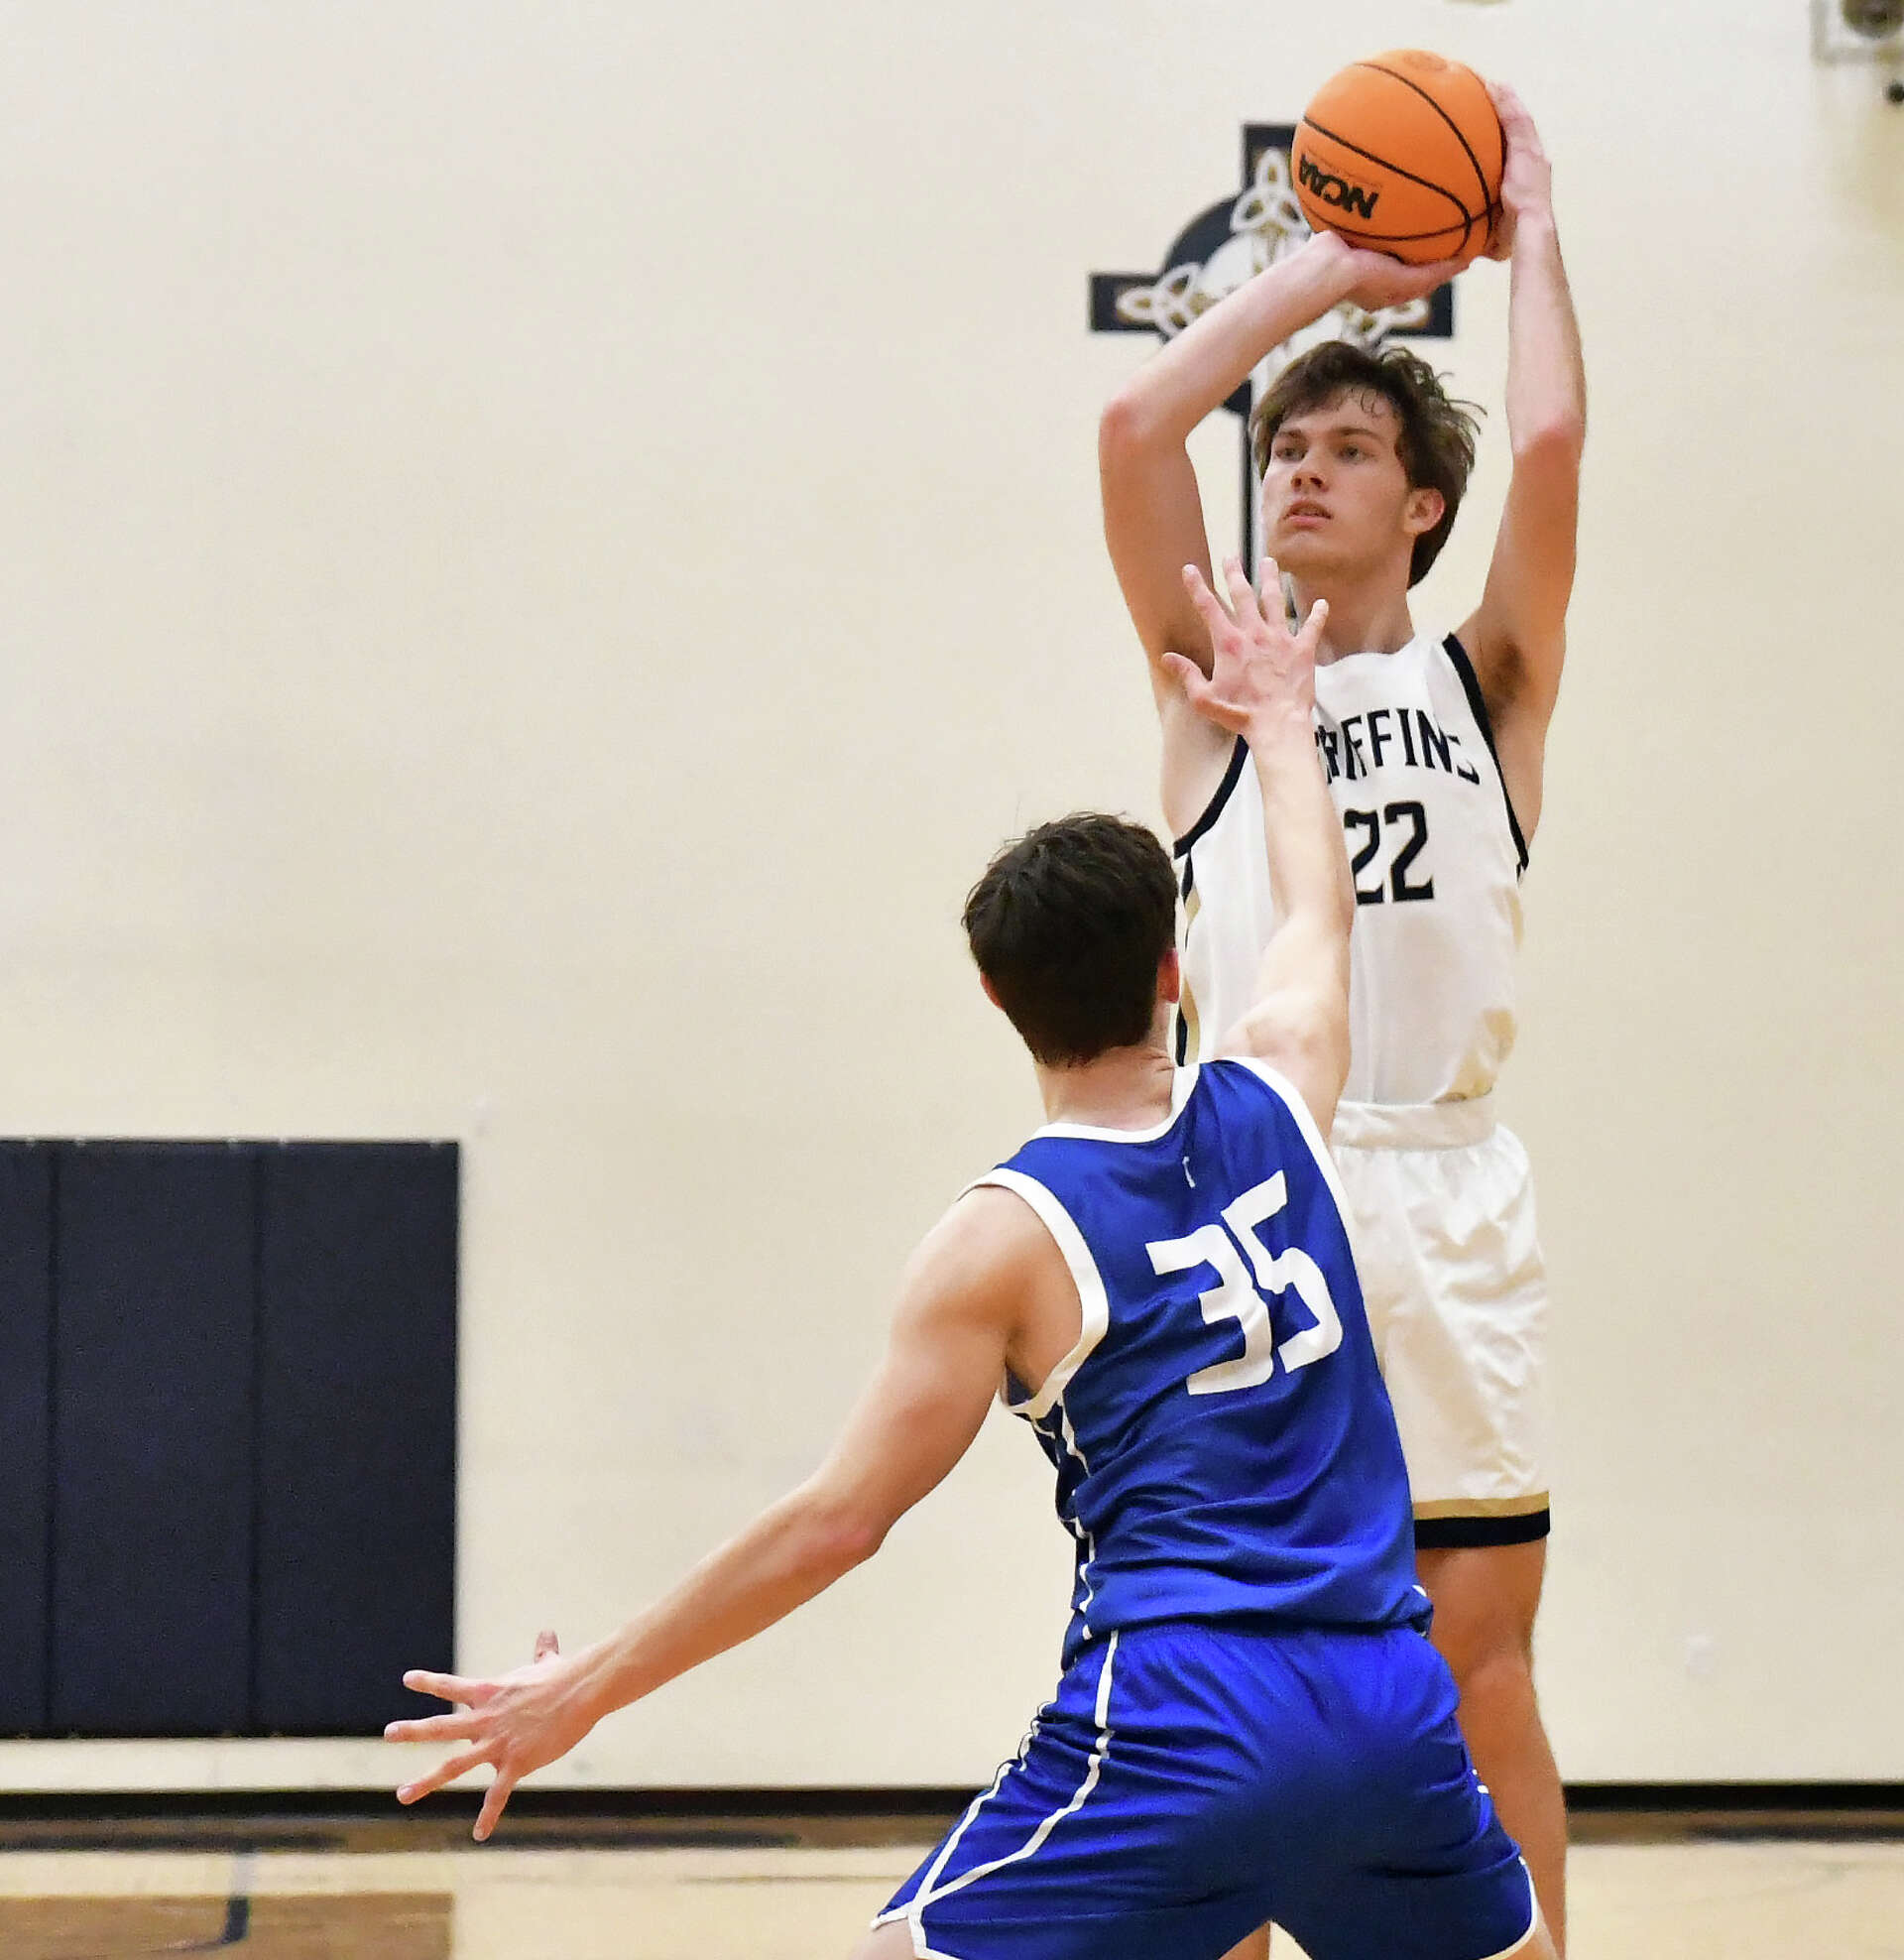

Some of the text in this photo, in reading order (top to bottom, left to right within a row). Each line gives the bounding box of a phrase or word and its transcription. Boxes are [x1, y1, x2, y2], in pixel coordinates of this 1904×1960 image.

[1299, 154, 1378, 219] NCAA
[1343, 799, 1434, 905] 22
[1144, 1168, 1344, 1396] 35
